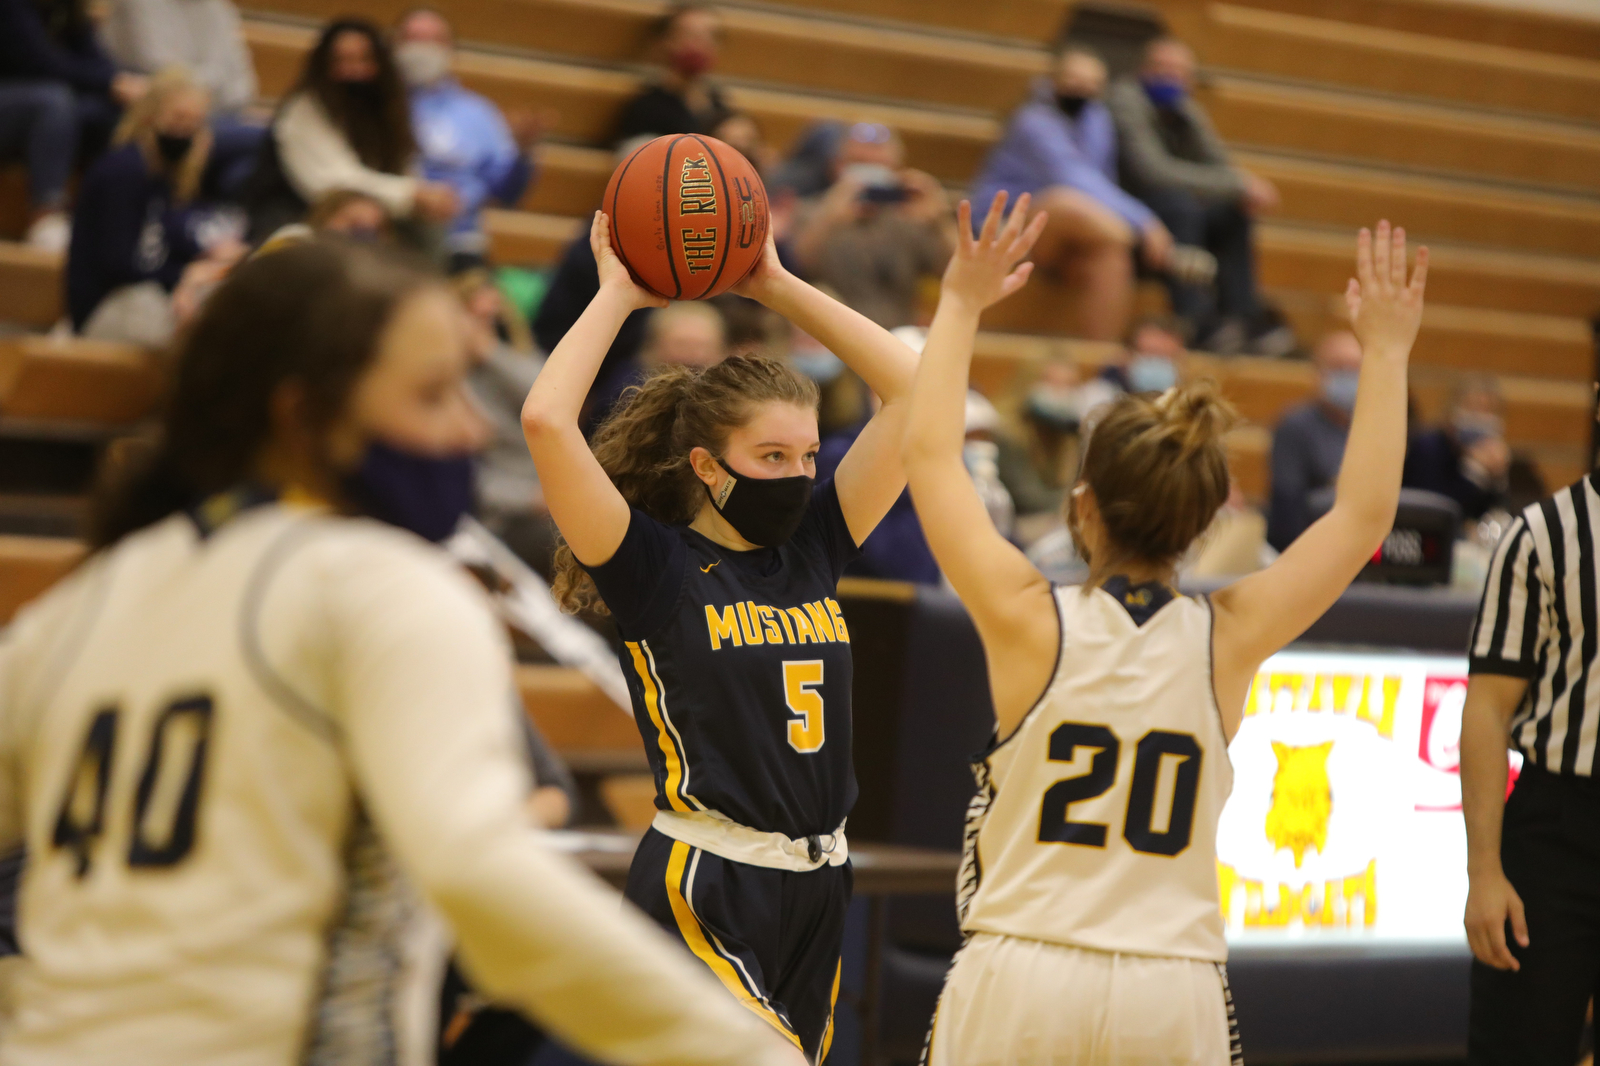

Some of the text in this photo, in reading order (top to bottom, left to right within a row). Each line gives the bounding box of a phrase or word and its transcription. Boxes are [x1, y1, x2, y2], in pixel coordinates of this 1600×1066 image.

[680, 156, 718, 275] THE ROCK
[781, 659, 826, 754] 5
[50, 690, 214, 880] 40
[1035, 719, 1205, 860] 20
